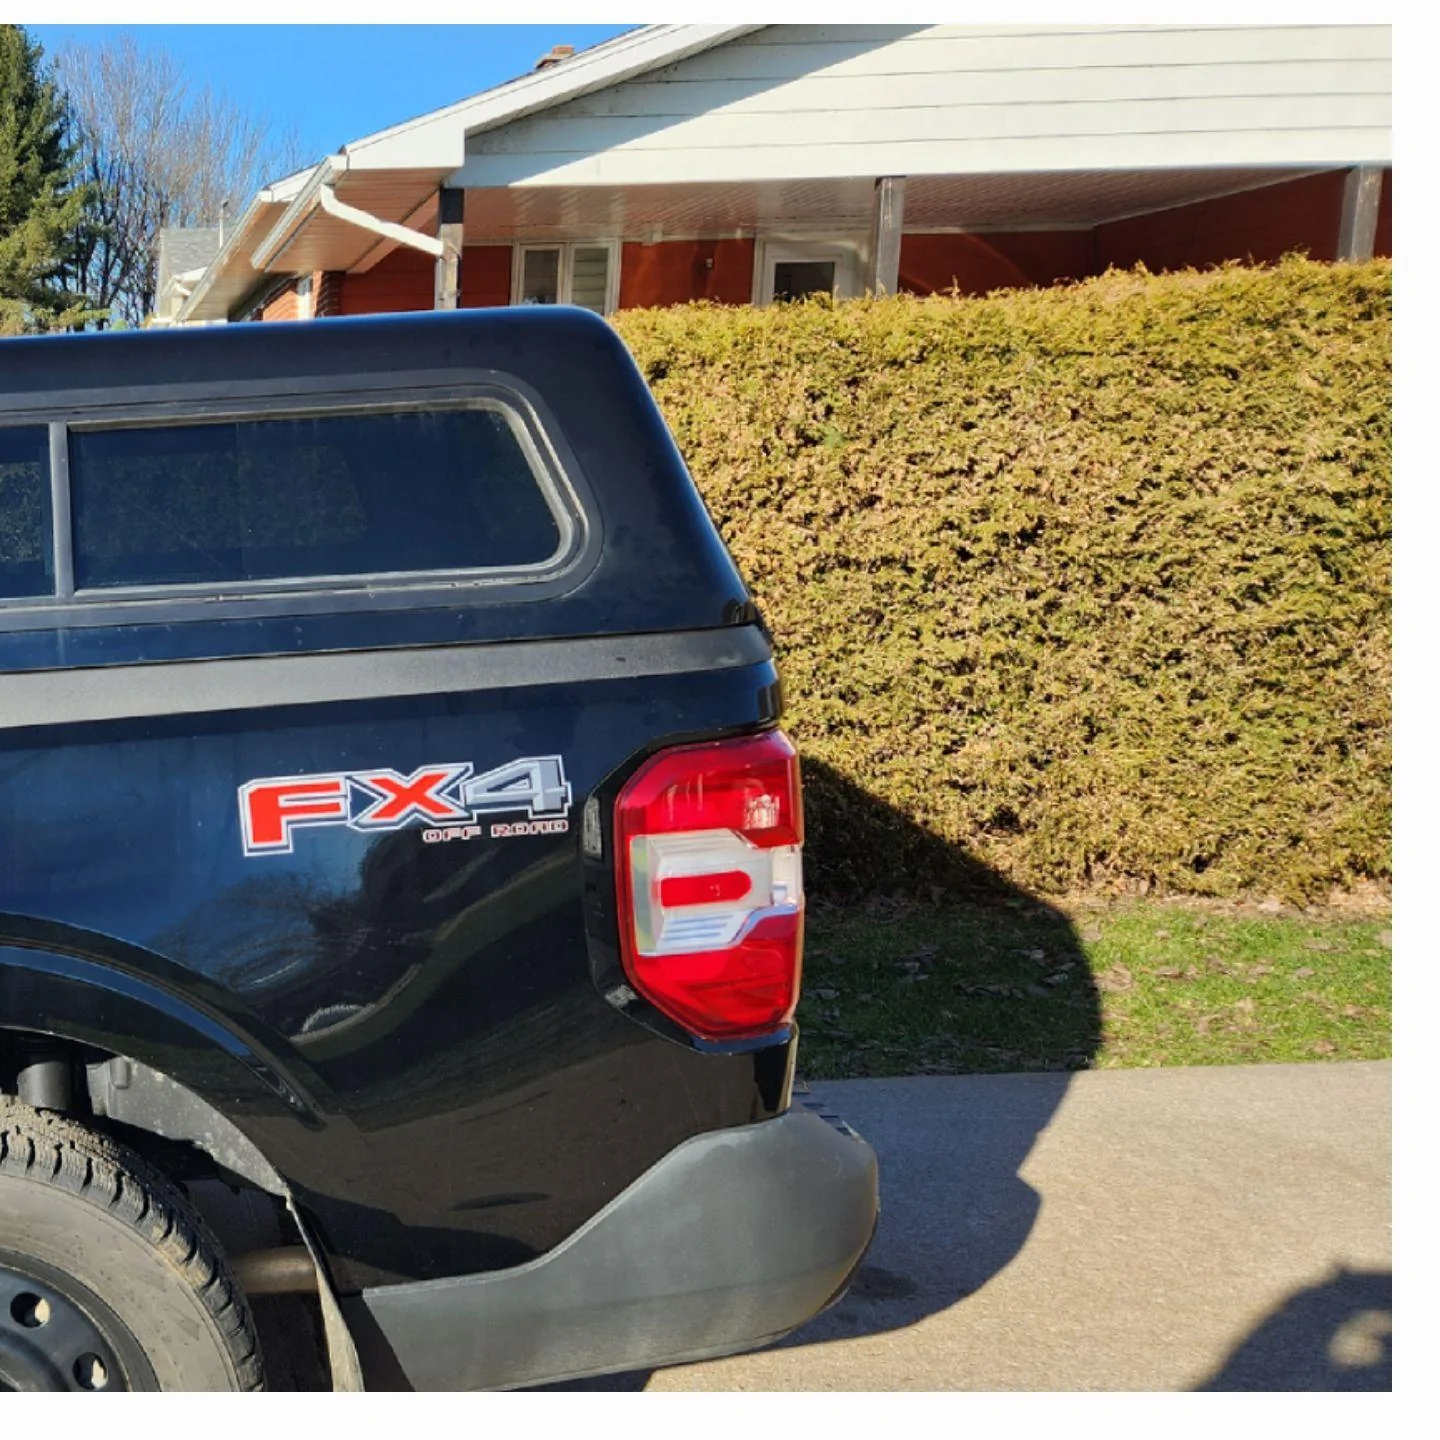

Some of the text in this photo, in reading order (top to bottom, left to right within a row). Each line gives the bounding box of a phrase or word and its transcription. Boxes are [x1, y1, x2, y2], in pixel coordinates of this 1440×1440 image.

[238, 755, 572, 857] FX4
[423, 820, 568, 843] OFF ROAD
